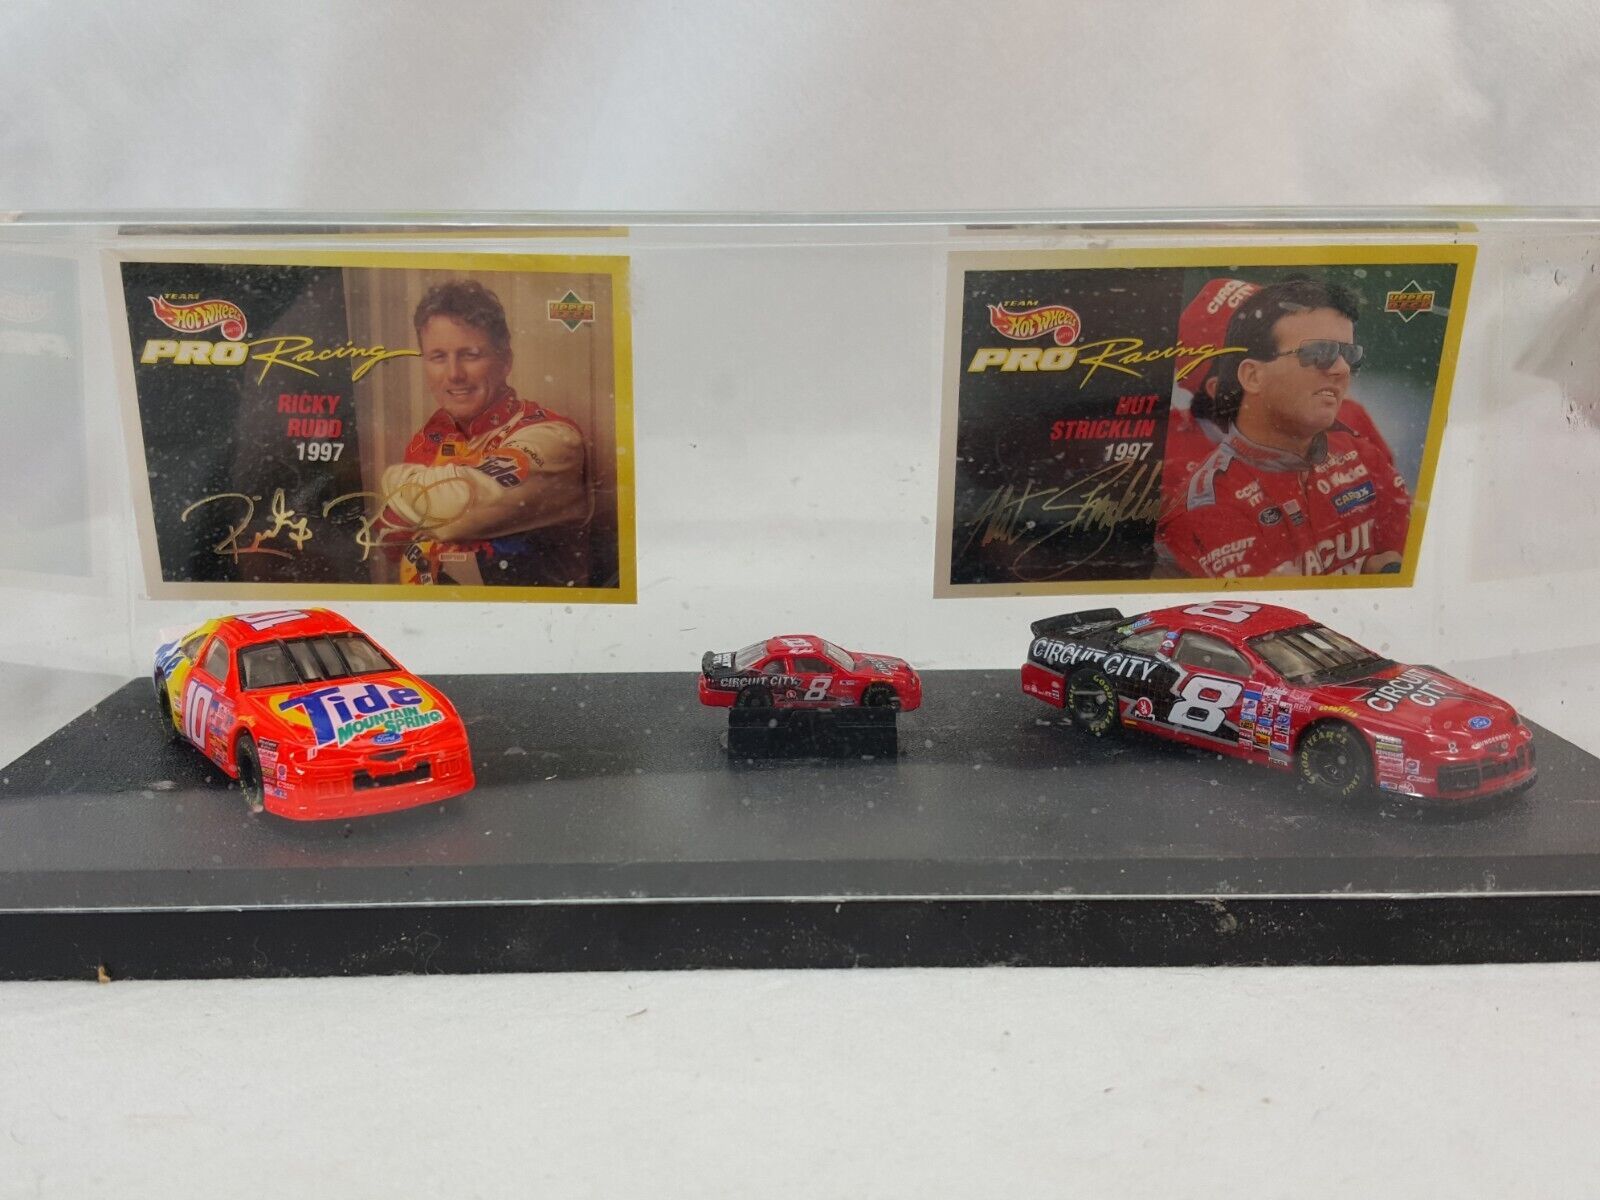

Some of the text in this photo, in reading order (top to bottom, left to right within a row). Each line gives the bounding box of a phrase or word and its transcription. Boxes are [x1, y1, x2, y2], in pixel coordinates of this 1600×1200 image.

[140, 336, 422, 387] PRO Racing
[967, 337, 1248, 390] PRO Racing
[278, 394, 341, 415] RICKY
[1115, 395, 1160, 415] HUT
[288, 418, 343, 438] RUDD
[1050, 419, 1156, 441] STRICKLIN
[296, 442, 345, 462] 1997
[1104, 443, 1154, 462] 1997
[1183, 600, 1262, 623] 8
[1032, 637, 1108, 665] CIRCUIT
[720, 677, 769, 688] CIRCUIT
[803, 676, 833, 701] 8
[1366, 668, 1430, 713] CIRCUIT
[1409, 679, 1454, 707] CITY
[184, 677, 214, 752] 10
[278, 684, 424, 746] Tide
[1167, 674, 1244, 733] 8
[337, 707, 418, 746] MOUNTAIN
[384, 711, 444, 735] SPRING
